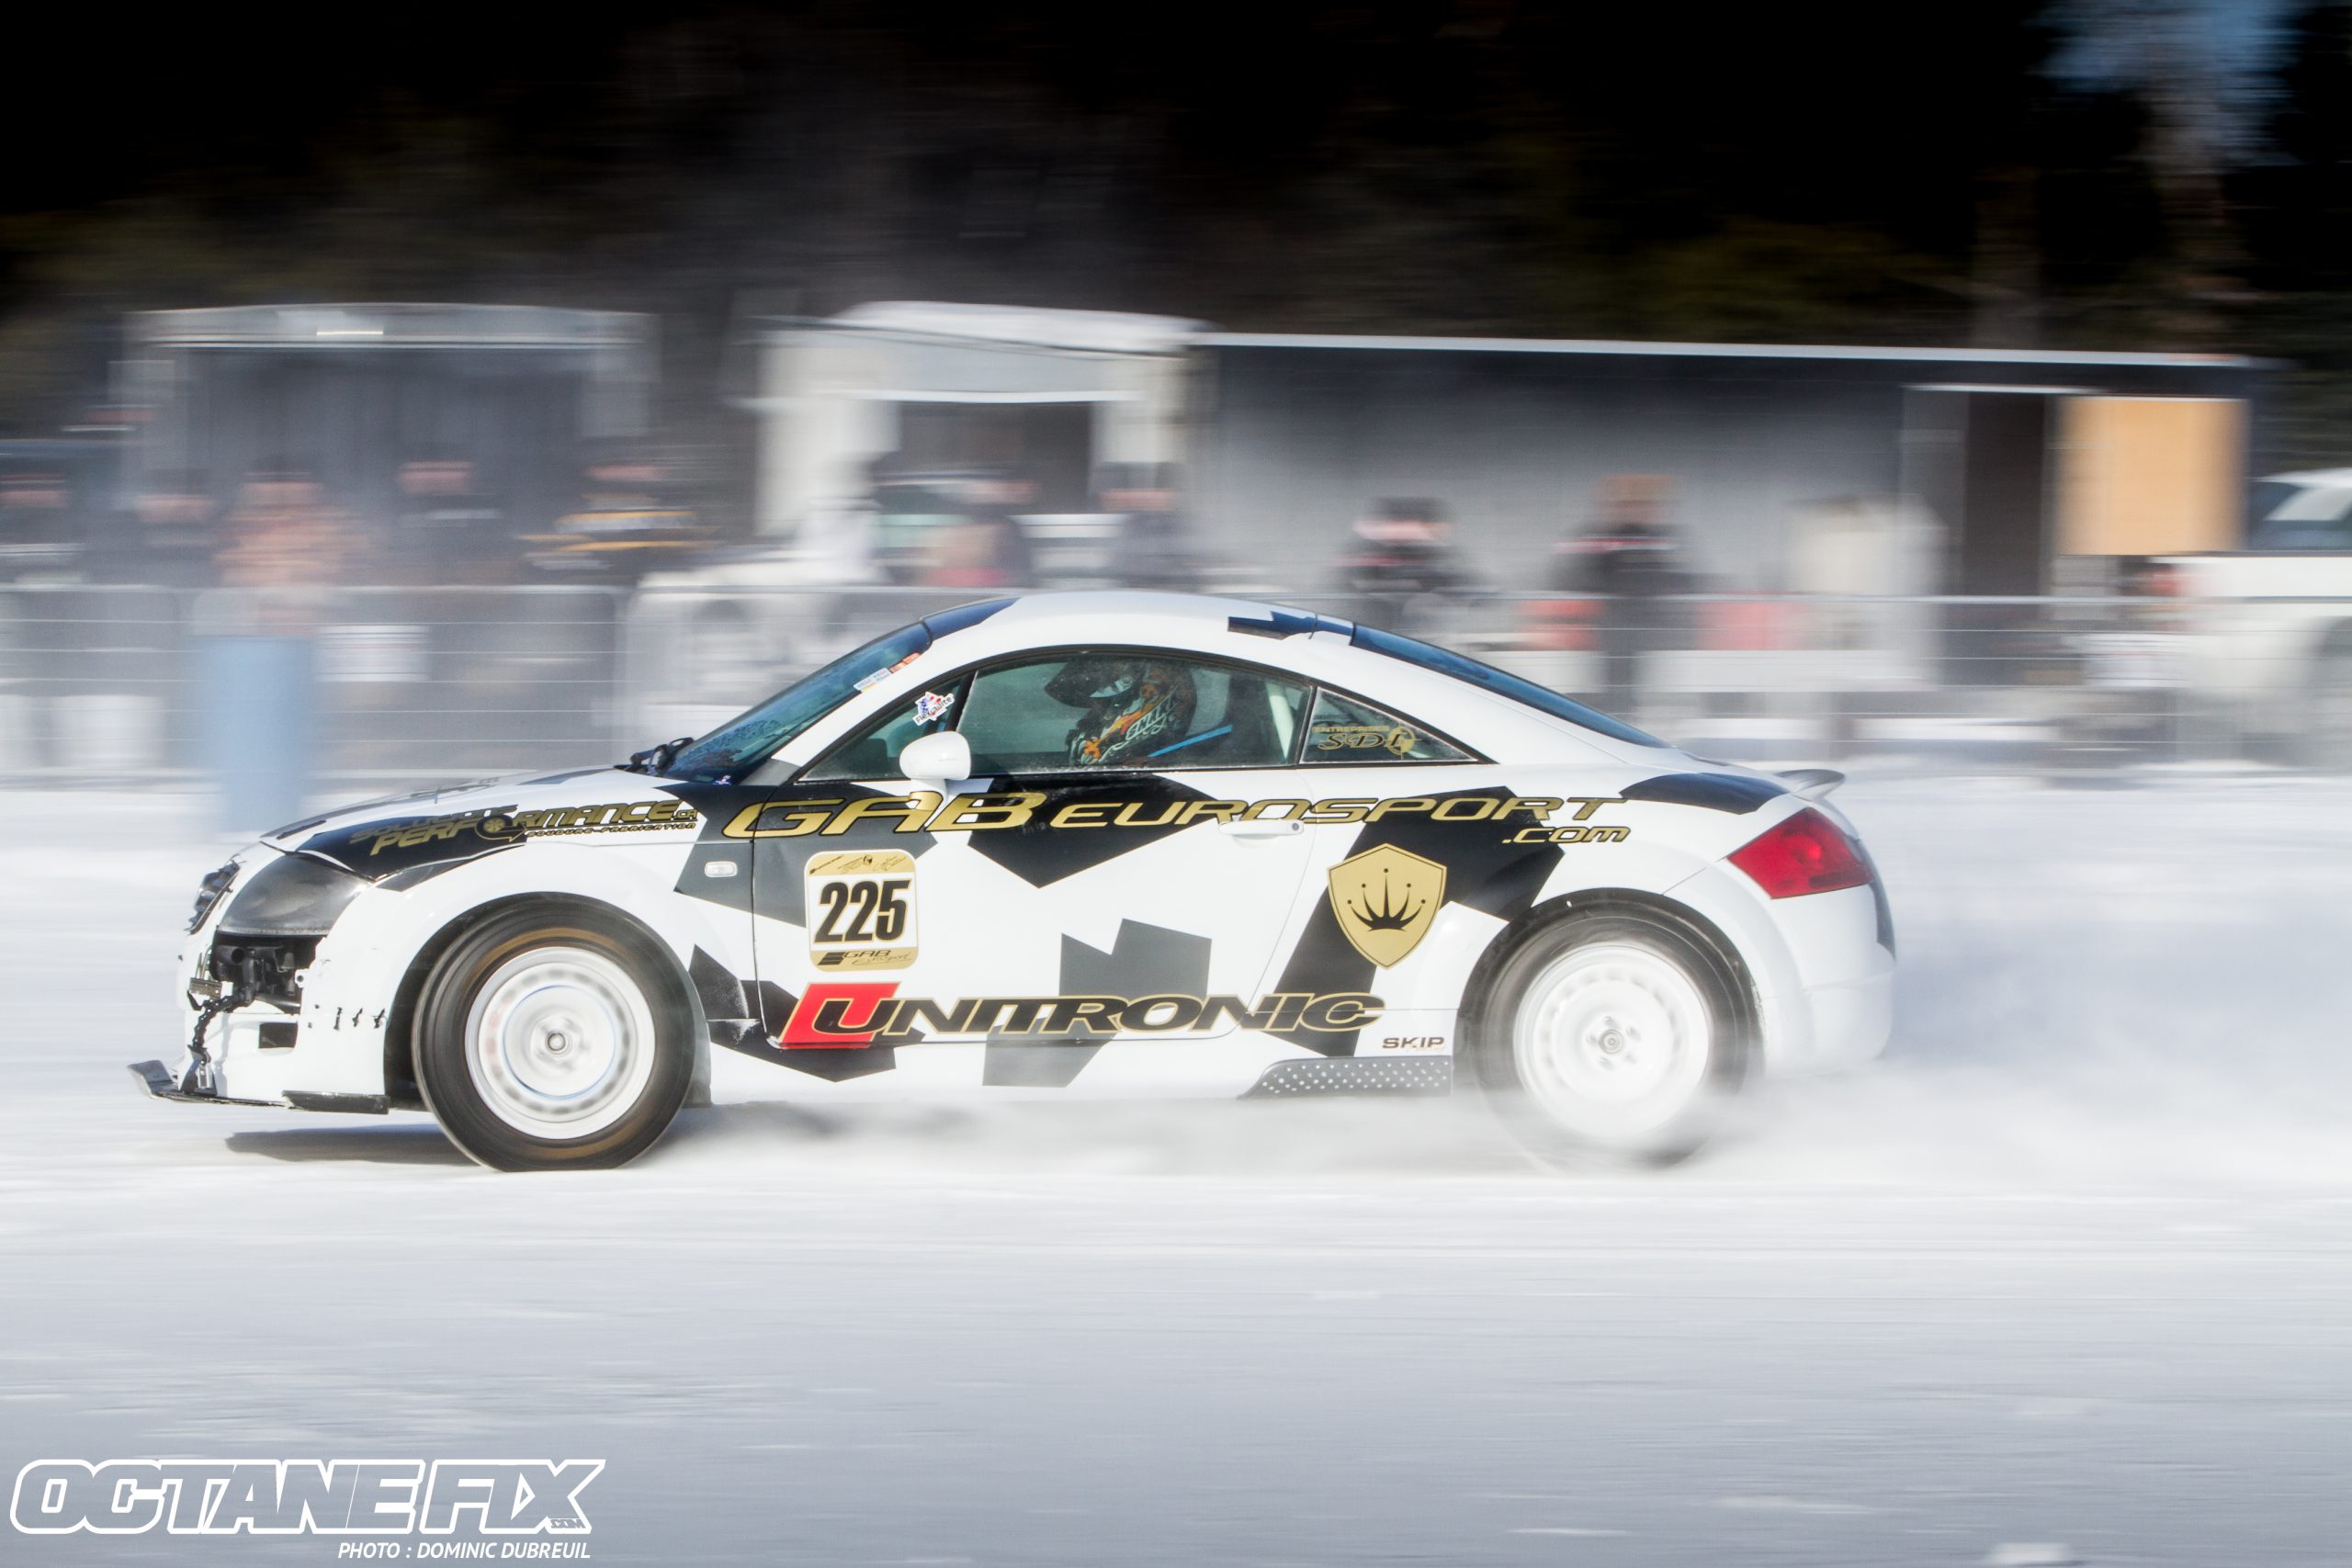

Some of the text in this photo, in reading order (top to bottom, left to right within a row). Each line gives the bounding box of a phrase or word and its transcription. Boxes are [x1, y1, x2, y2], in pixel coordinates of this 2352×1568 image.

[722, 790, 1046, 838] GAB
[814, 879, 911, 943] 225
[808, 993, 1386, 1035] UNITRONIC
[1381, 1036, 1445, 1049] SKIP
